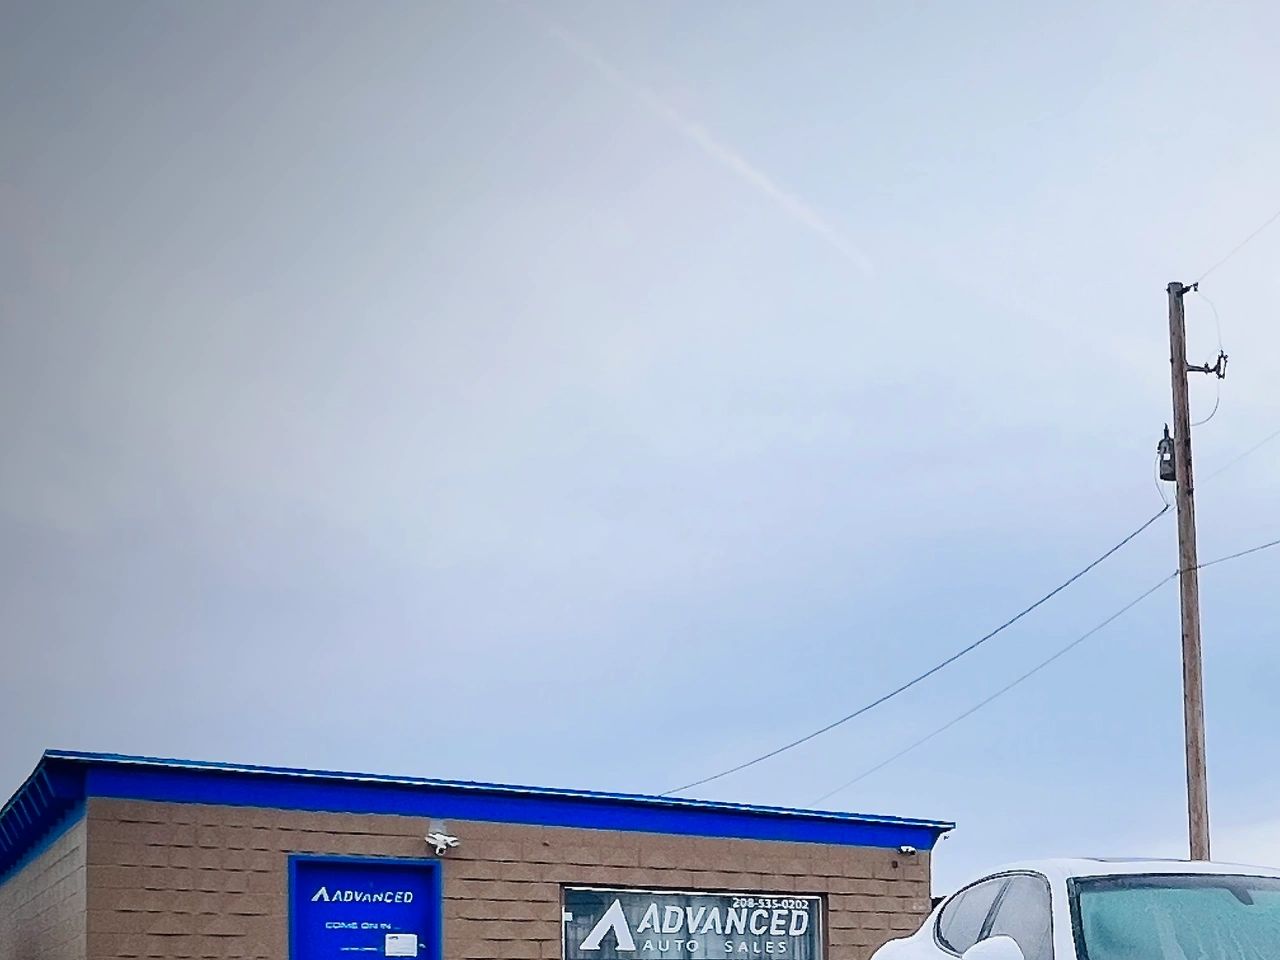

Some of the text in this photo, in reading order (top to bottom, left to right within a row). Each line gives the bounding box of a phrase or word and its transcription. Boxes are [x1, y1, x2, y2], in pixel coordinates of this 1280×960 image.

[331, 890, 413, 903] ADVANCED
[732, 898, 809, 910] 208-535-0202
[637, 903, 809, 936] ADVANCED
[642, 939, 787, 954] AUTO SALES
